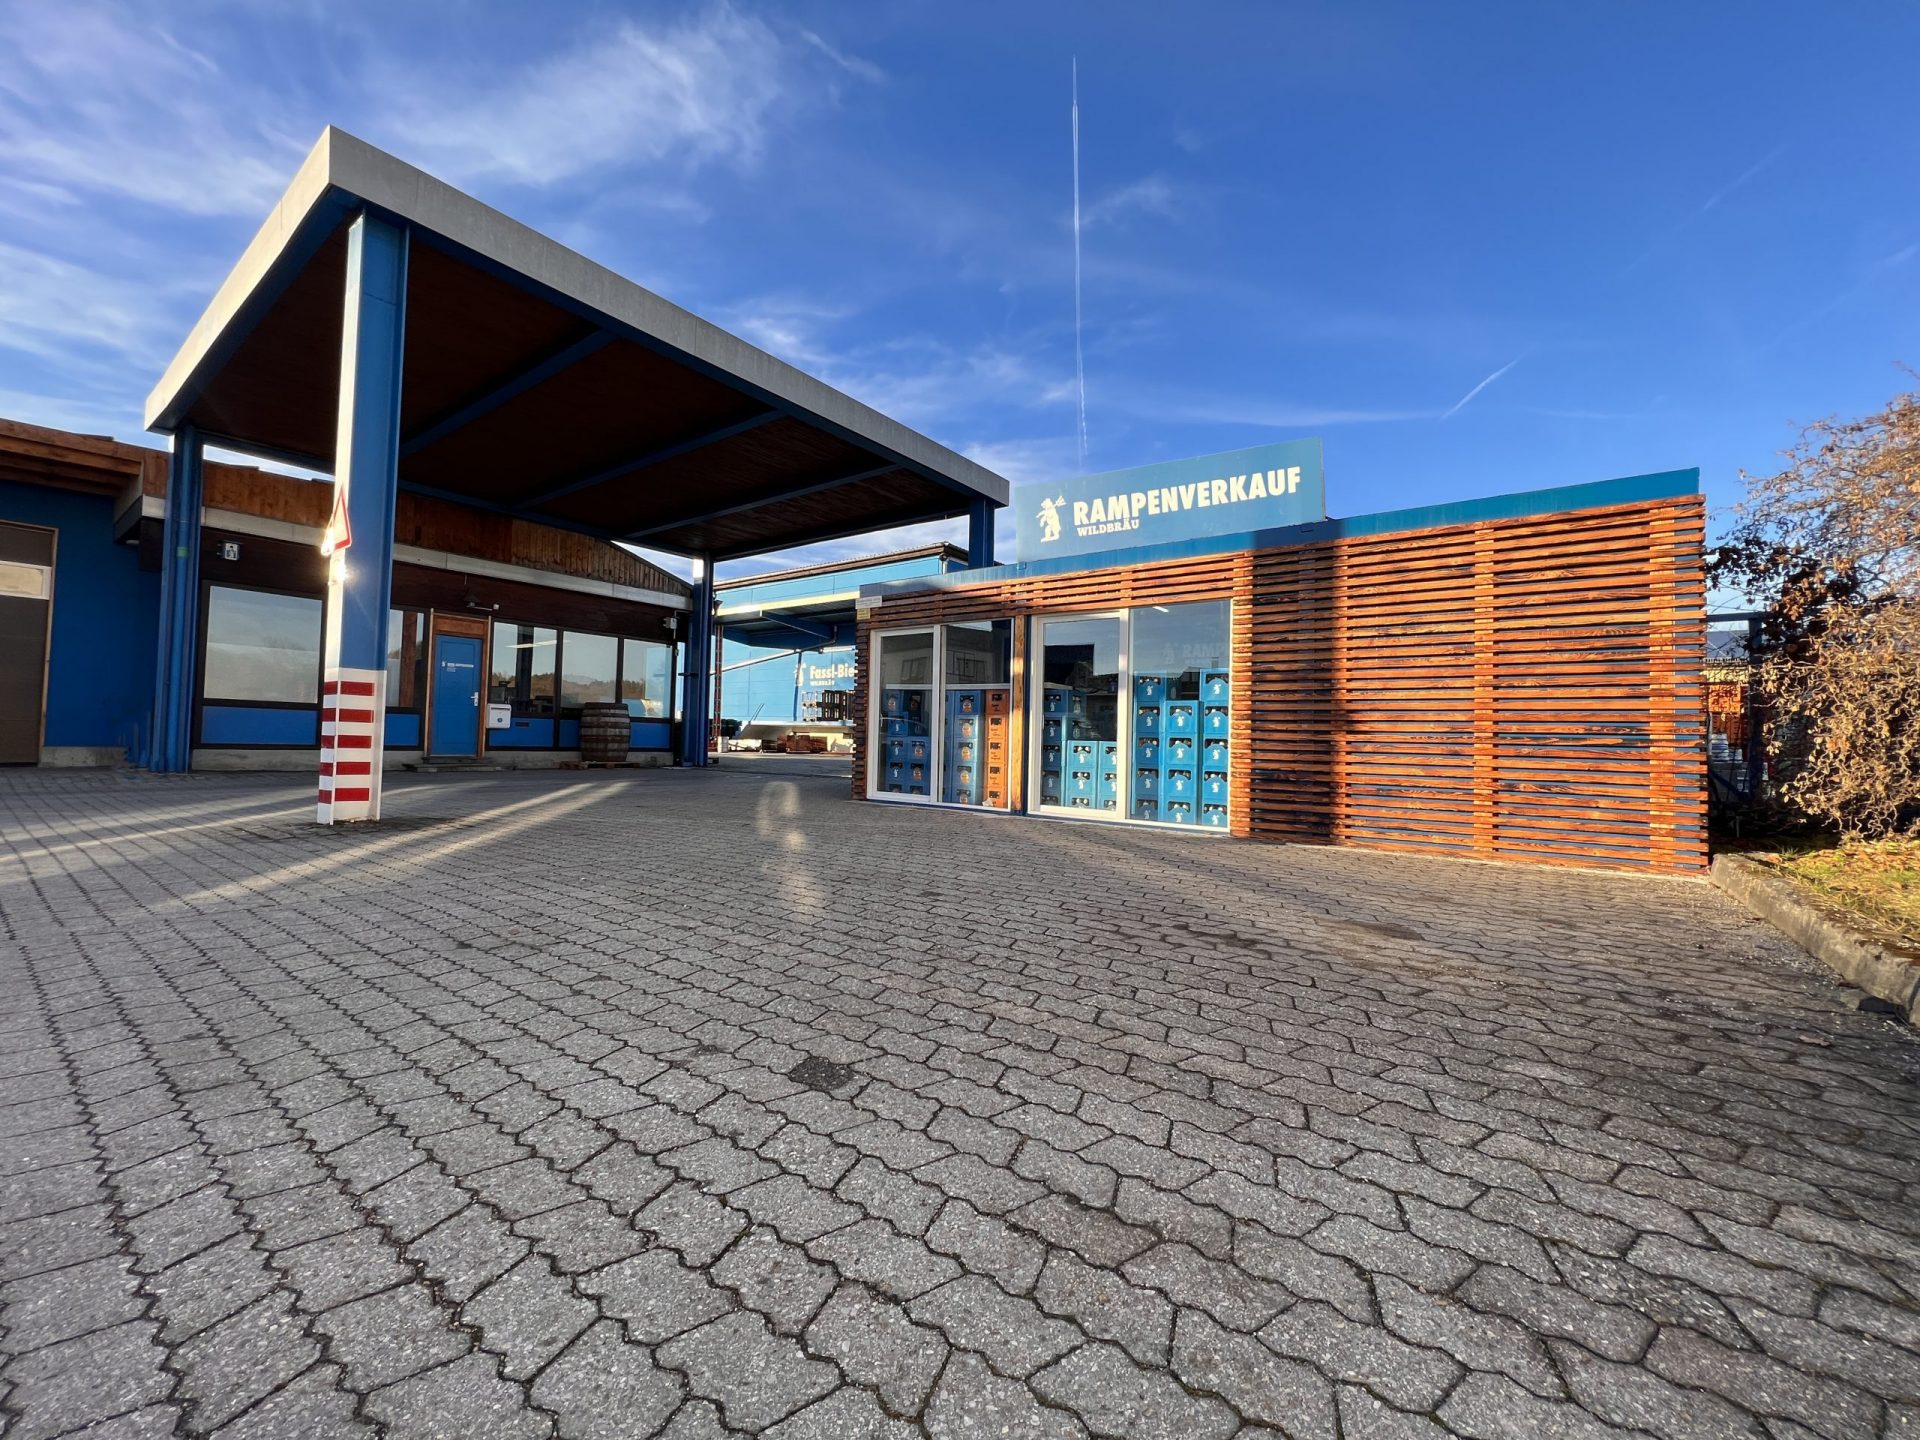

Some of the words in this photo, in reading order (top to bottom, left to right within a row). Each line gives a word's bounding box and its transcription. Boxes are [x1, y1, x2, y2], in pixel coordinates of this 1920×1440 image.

[1073, 466, 1300, 525] RAMPENVERKAUF
[1077, 519, 1139, 536] WILDBRÄU
[810, 663, 856, 678] Fassl-Bie
